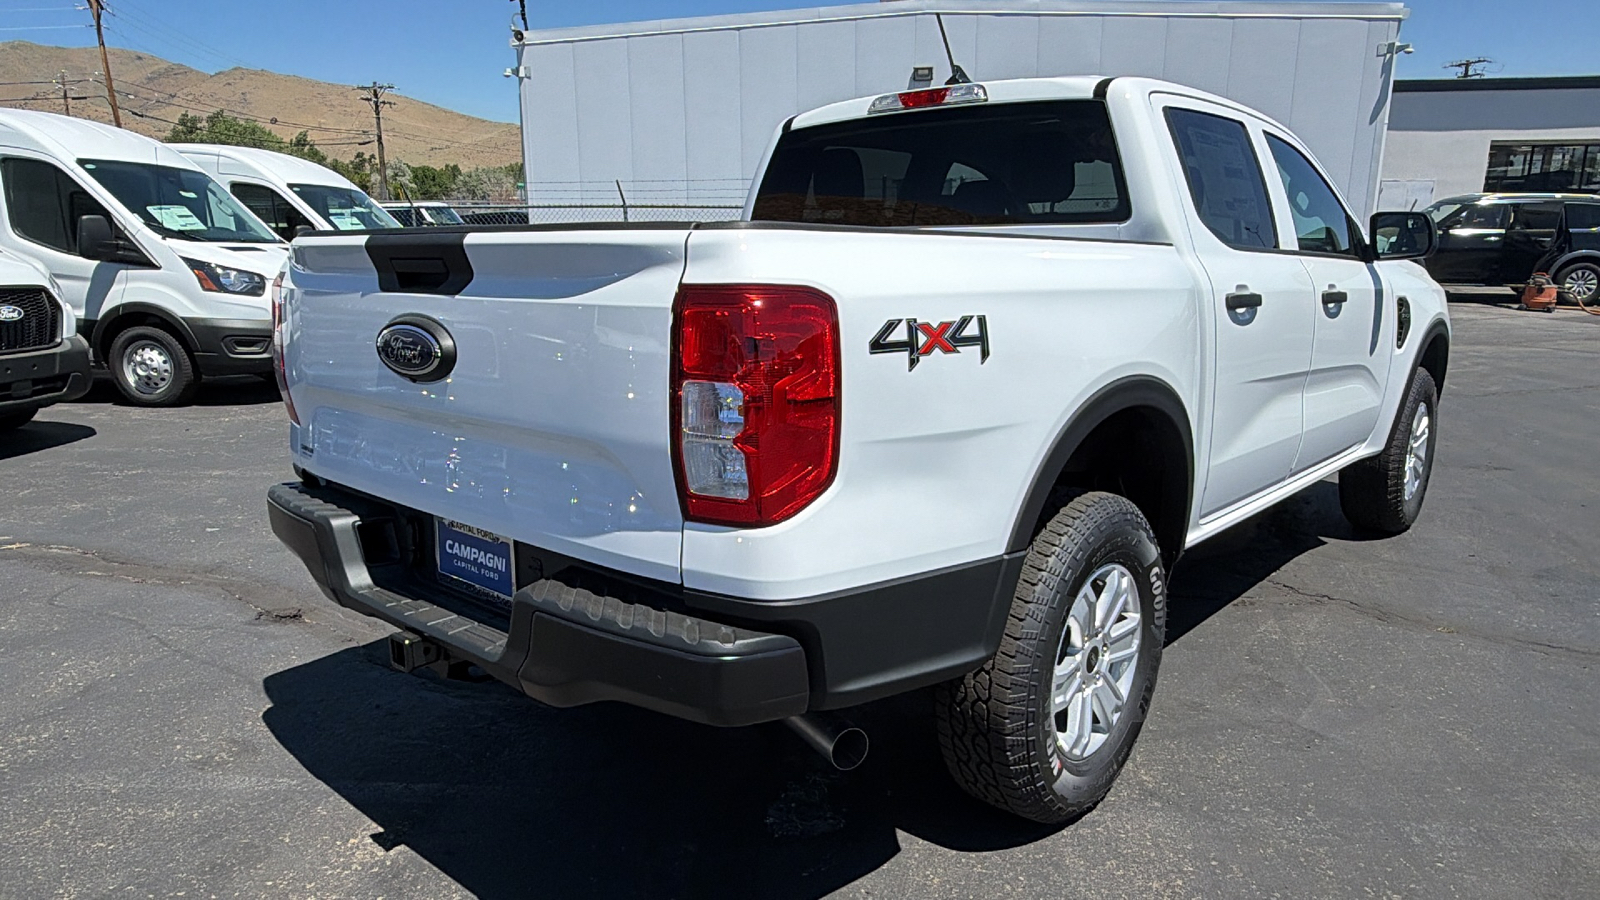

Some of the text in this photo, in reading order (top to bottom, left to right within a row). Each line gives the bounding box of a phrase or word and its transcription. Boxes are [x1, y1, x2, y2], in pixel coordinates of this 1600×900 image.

[388, 335, 422, 364] Ford
[476, 527, 495, 541] FORD
[445, 539, 506, 573] CAMPAGNI
[453, 559, 499, 581] CAPITAL FORD
